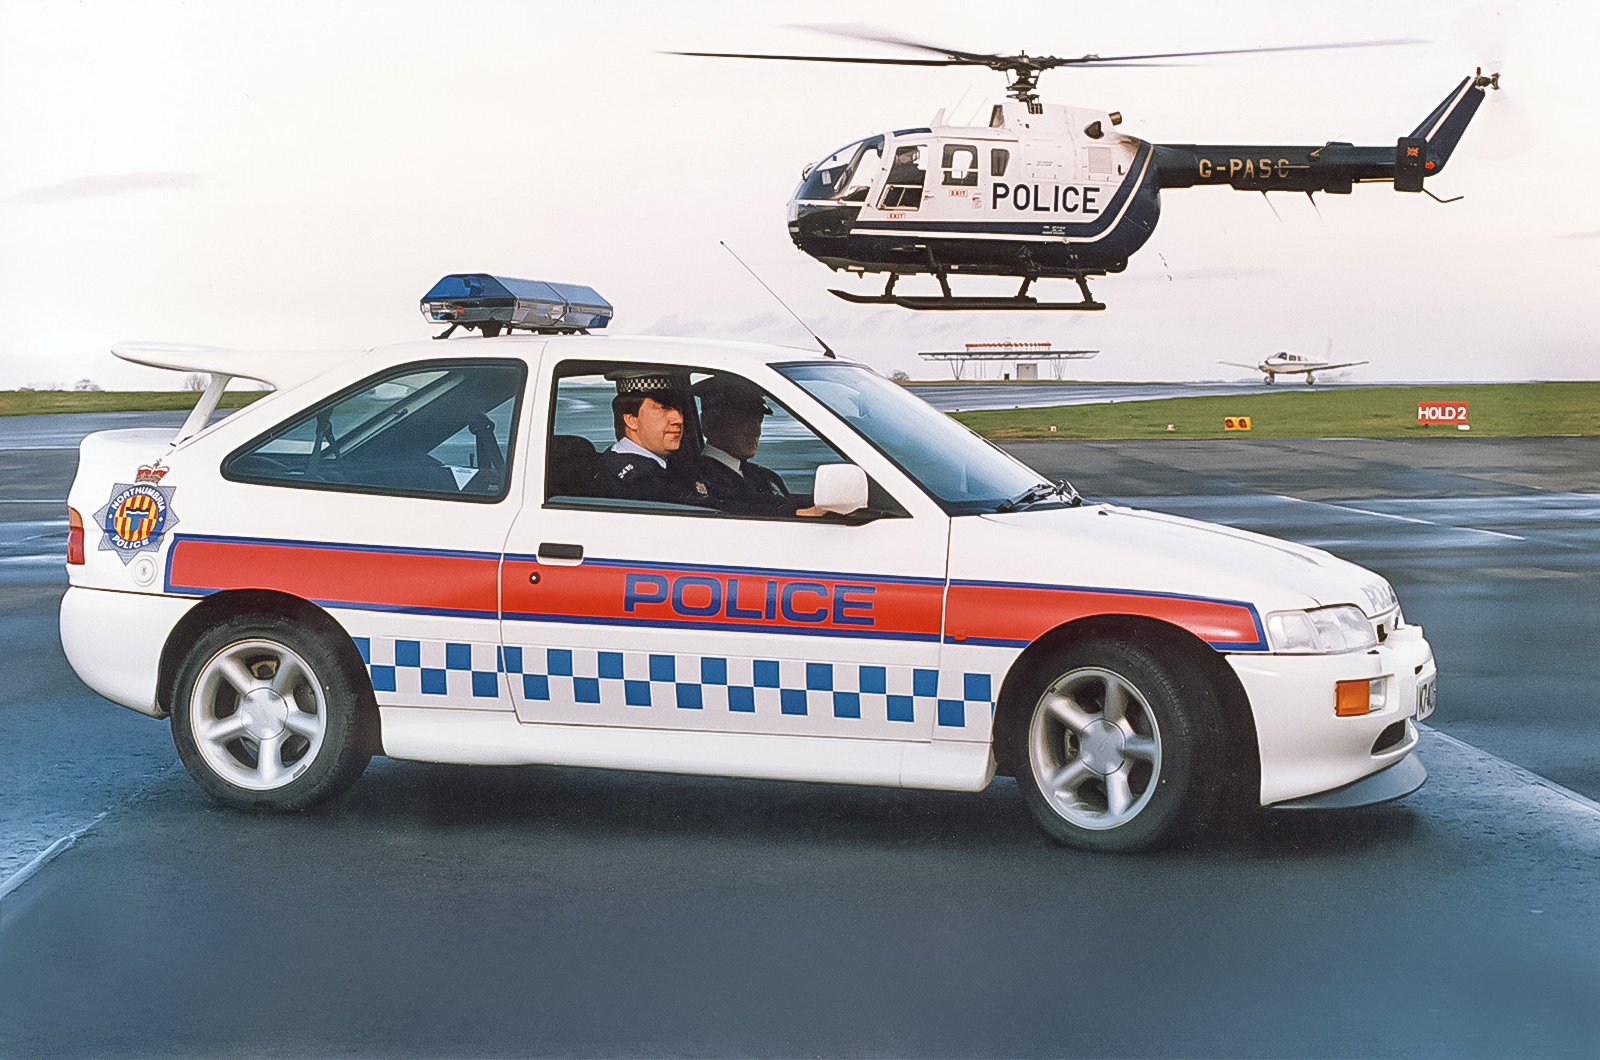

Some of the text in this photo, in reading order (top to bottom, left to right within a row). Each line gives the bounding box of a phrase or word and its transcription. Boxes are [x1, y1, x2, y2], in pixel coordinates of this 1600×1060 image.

[992, 182, 1100, 214] POLICE
[1418, 406, 1467, 420] HOLD 2
[110, 486, 166, 512] NORTHUMBRIA
[111, 534, 150, 549] POLICE
[623, 572, 877, 626] POLICE
